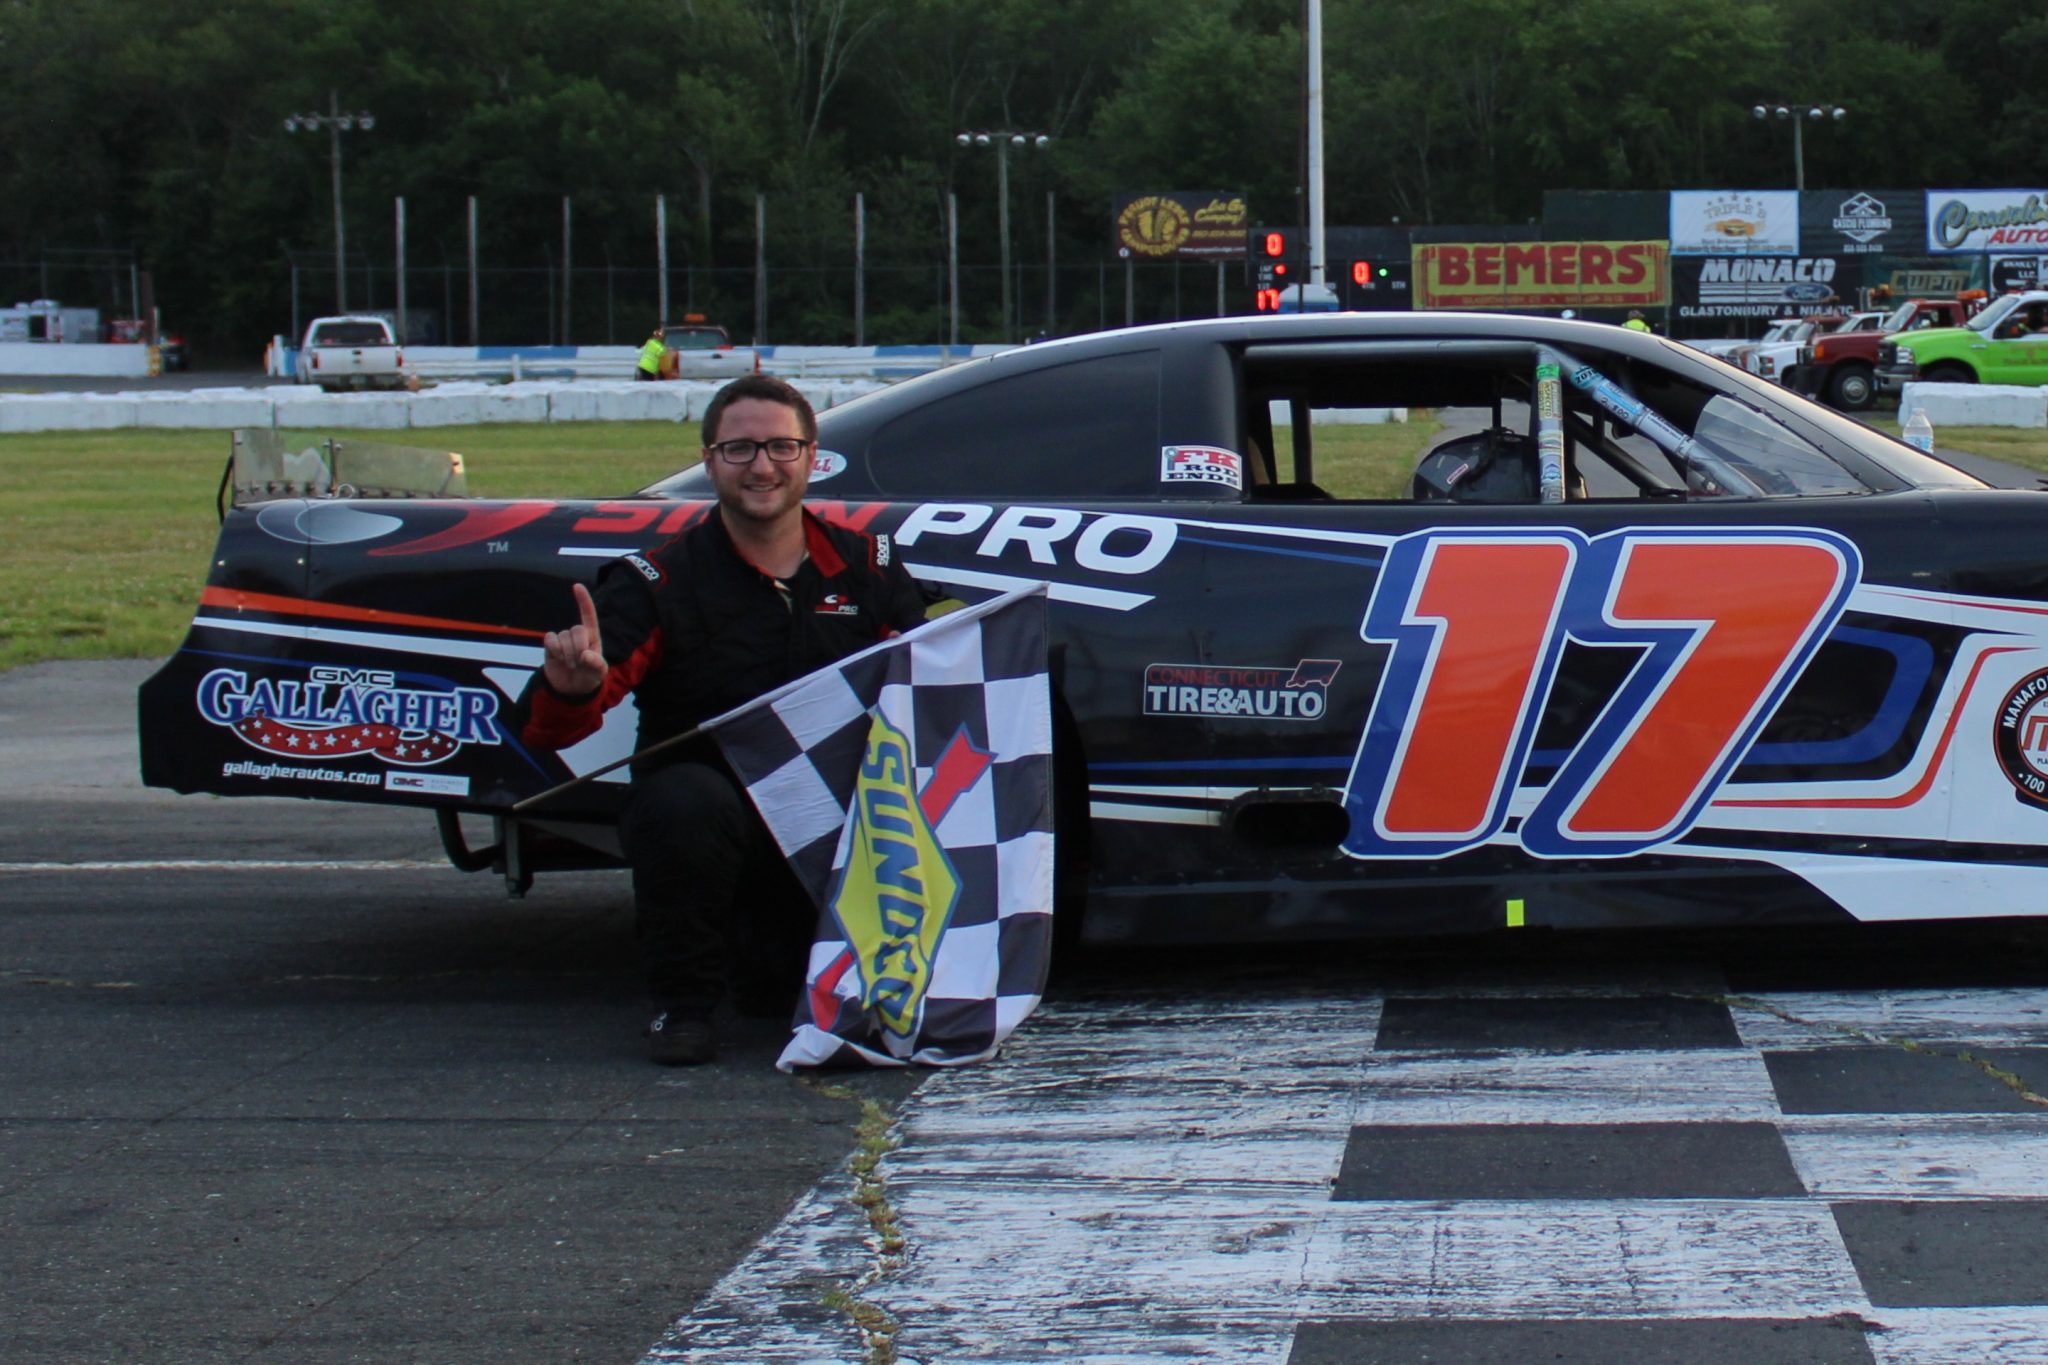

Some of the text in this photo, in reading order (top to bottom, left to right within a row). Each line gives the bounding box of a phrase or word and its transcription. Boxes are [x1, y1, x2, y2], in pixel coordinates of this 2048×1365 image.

[1438, 244, 1648, 287] BEMERS
[1699, 258, 1837, 283] MONACO
[1680, 305, 1778, 317] GLASTONBURY
[1166, 471, 1238, 487] ENDS
[1183, 464, 1238, 478] ROD
[487, 541, 508, 554] TM
[894, 502, 1179, 574] PRO
[310, 665, 395, 687] GMC
[1148, 667, 1280, 688] CONNECTICUT
[1340, 525, 1864, 860] 17
[197, 668, 501, 745] GALLAGHER
[222, 761, 381, 785] gallagherautos.com
[2024, 774, 2046, 793] 100
[861, 738, 926, 1024] SUNOCO
